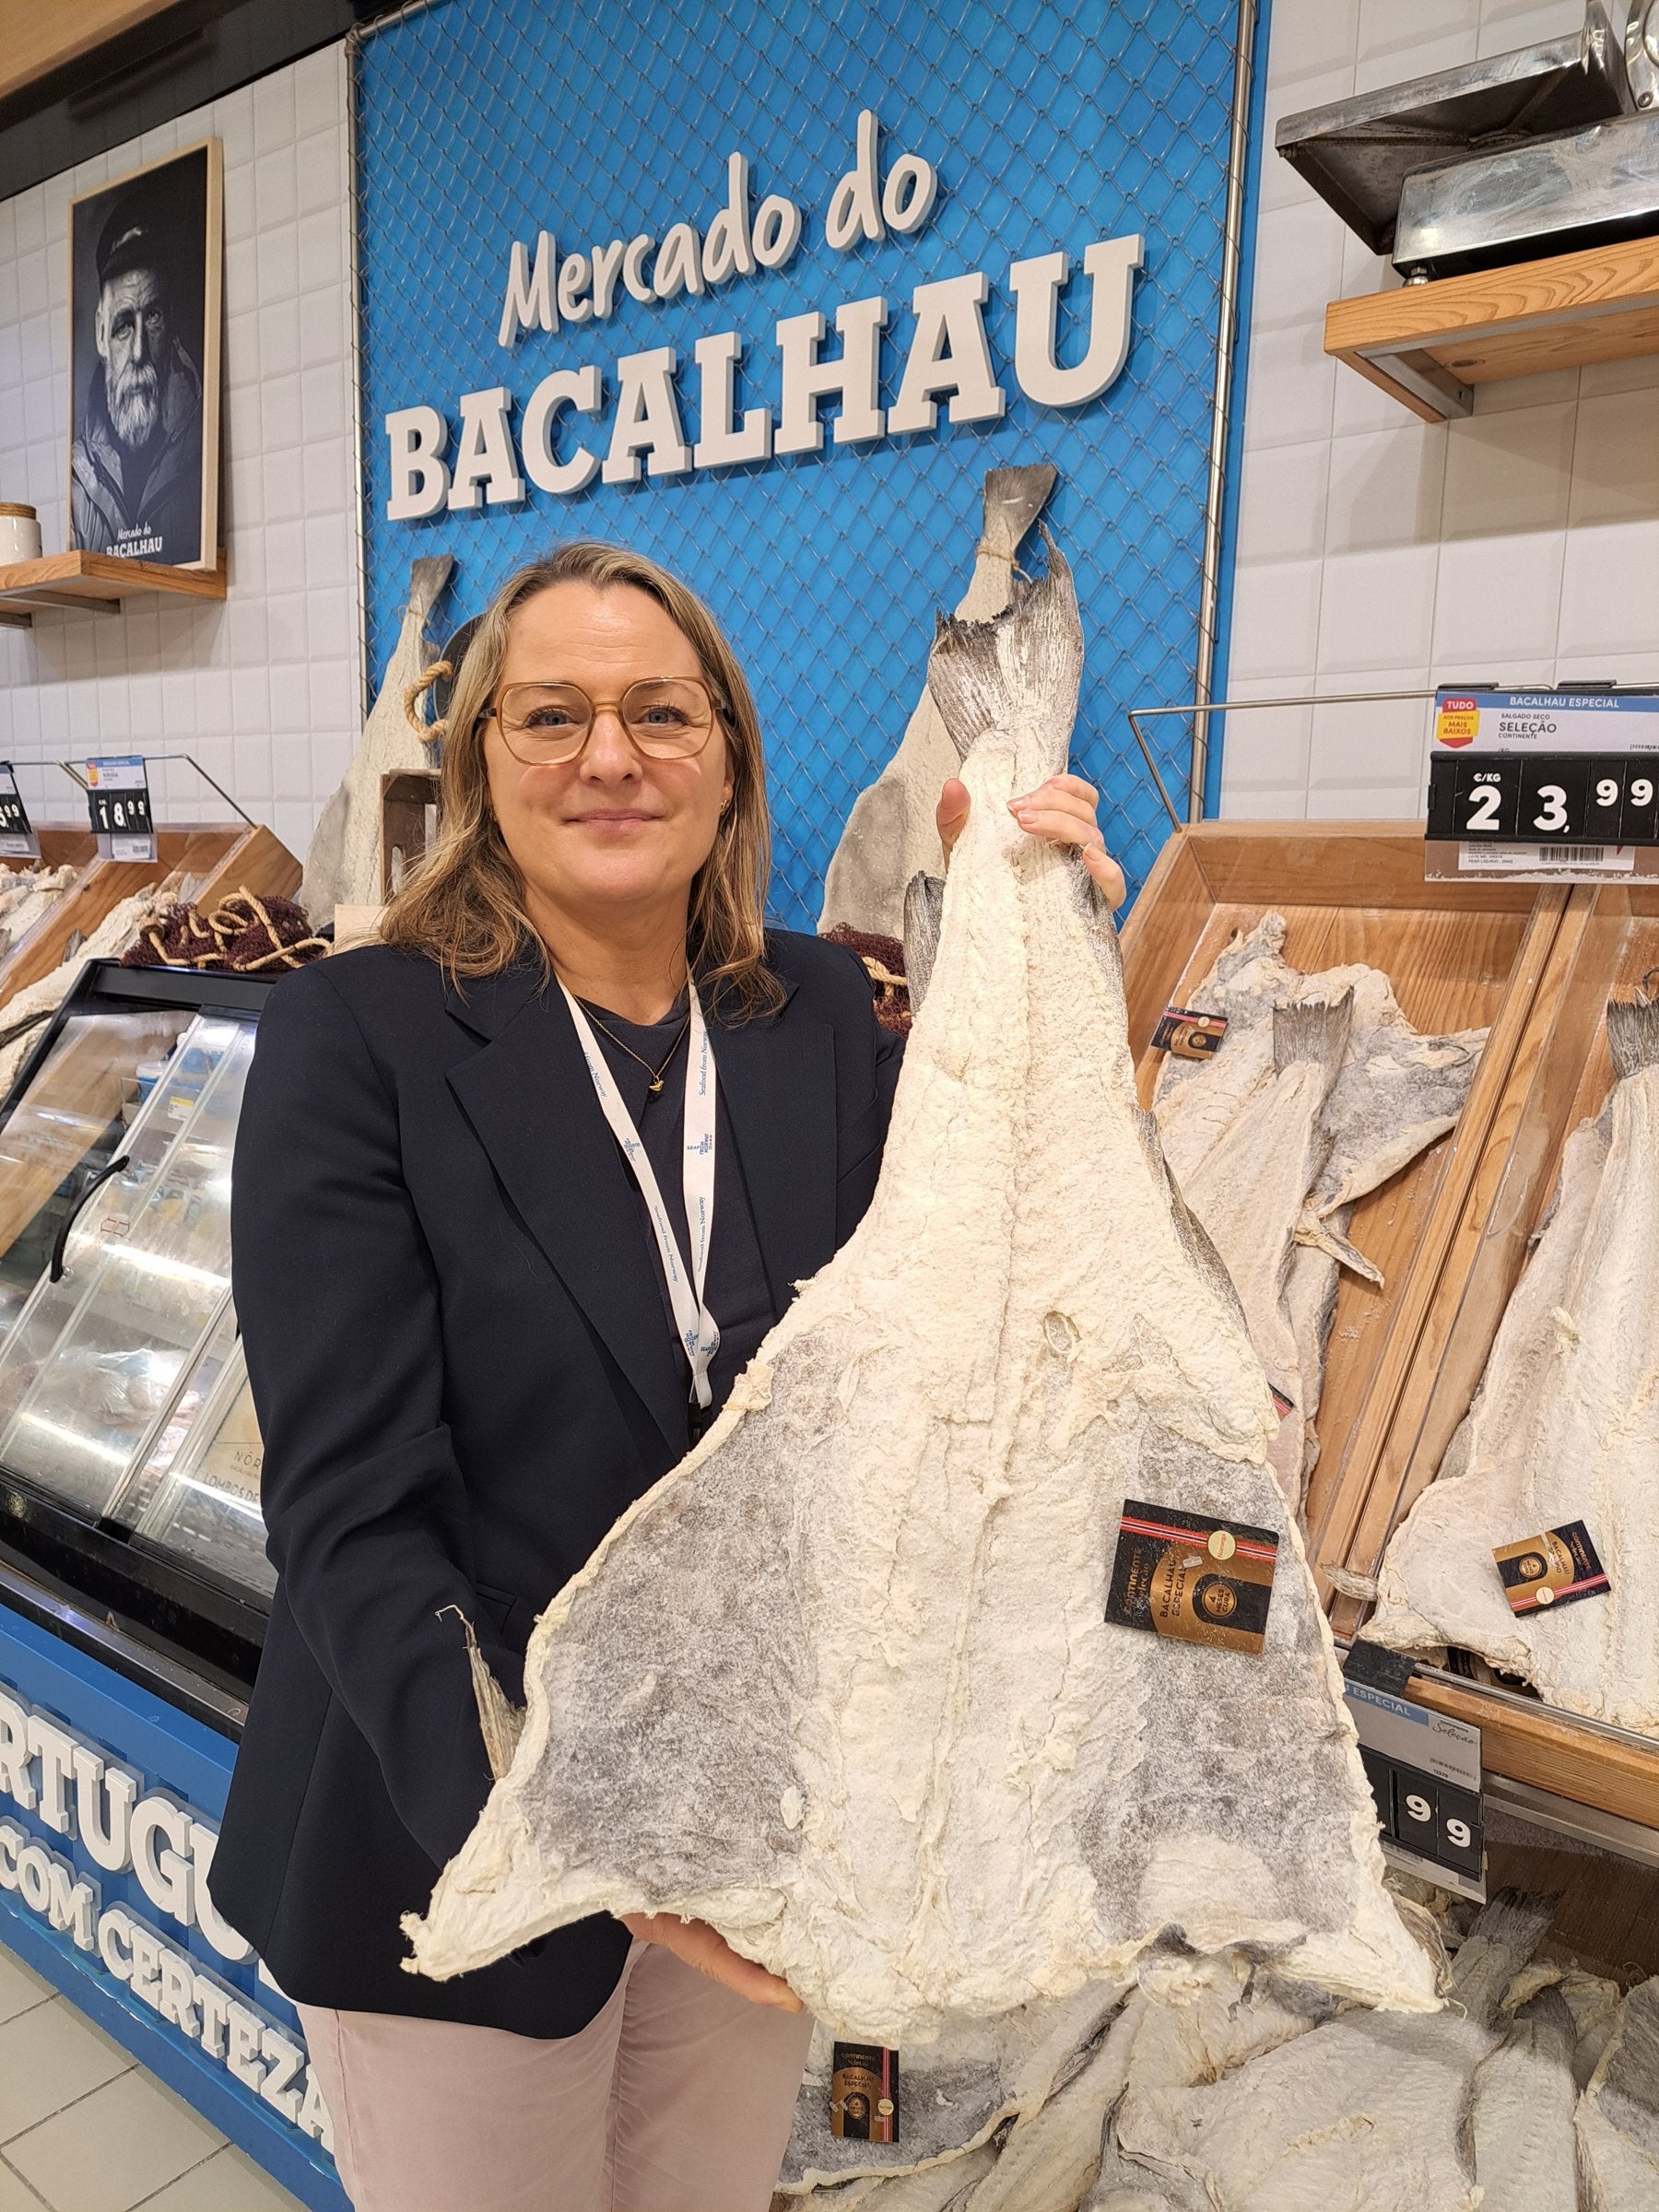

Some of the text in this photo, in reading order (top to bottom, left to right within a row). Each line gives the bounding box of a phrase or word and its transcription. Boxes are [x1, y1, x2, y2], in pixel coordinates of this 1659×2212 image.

[499, 109, 938, 348] Mercado do
[385, 234, 1145, 523] BACALHAU
[117, 521, 151, 541] Mercado do
[106, 536, 163, 558] BACALHAU
[1447, 701, 1474, 710] TUDO
[1510, 697, 1619, 708] BACALHAU ESPECIAL
[1499, 721, 1557, 735] SELEÇÃO
[1473, 772, 1501, 782] €/KG
[699, 1069, 707, 1096] Seafood
[1552, 1540, 1571, 1575] BACALHAU
[1159, 1559, 1177, 1618] BACALHAU
[1208, 1595, 1217, 1604] 4
[1216, 1588, 1225, 1613] MESES
[1222, 1591, 1230, 1613] CURA
[1353, 1686, 1411, 1717] ESPECIAL
[0, 1825, 335, 2155] COM CERTEZA
